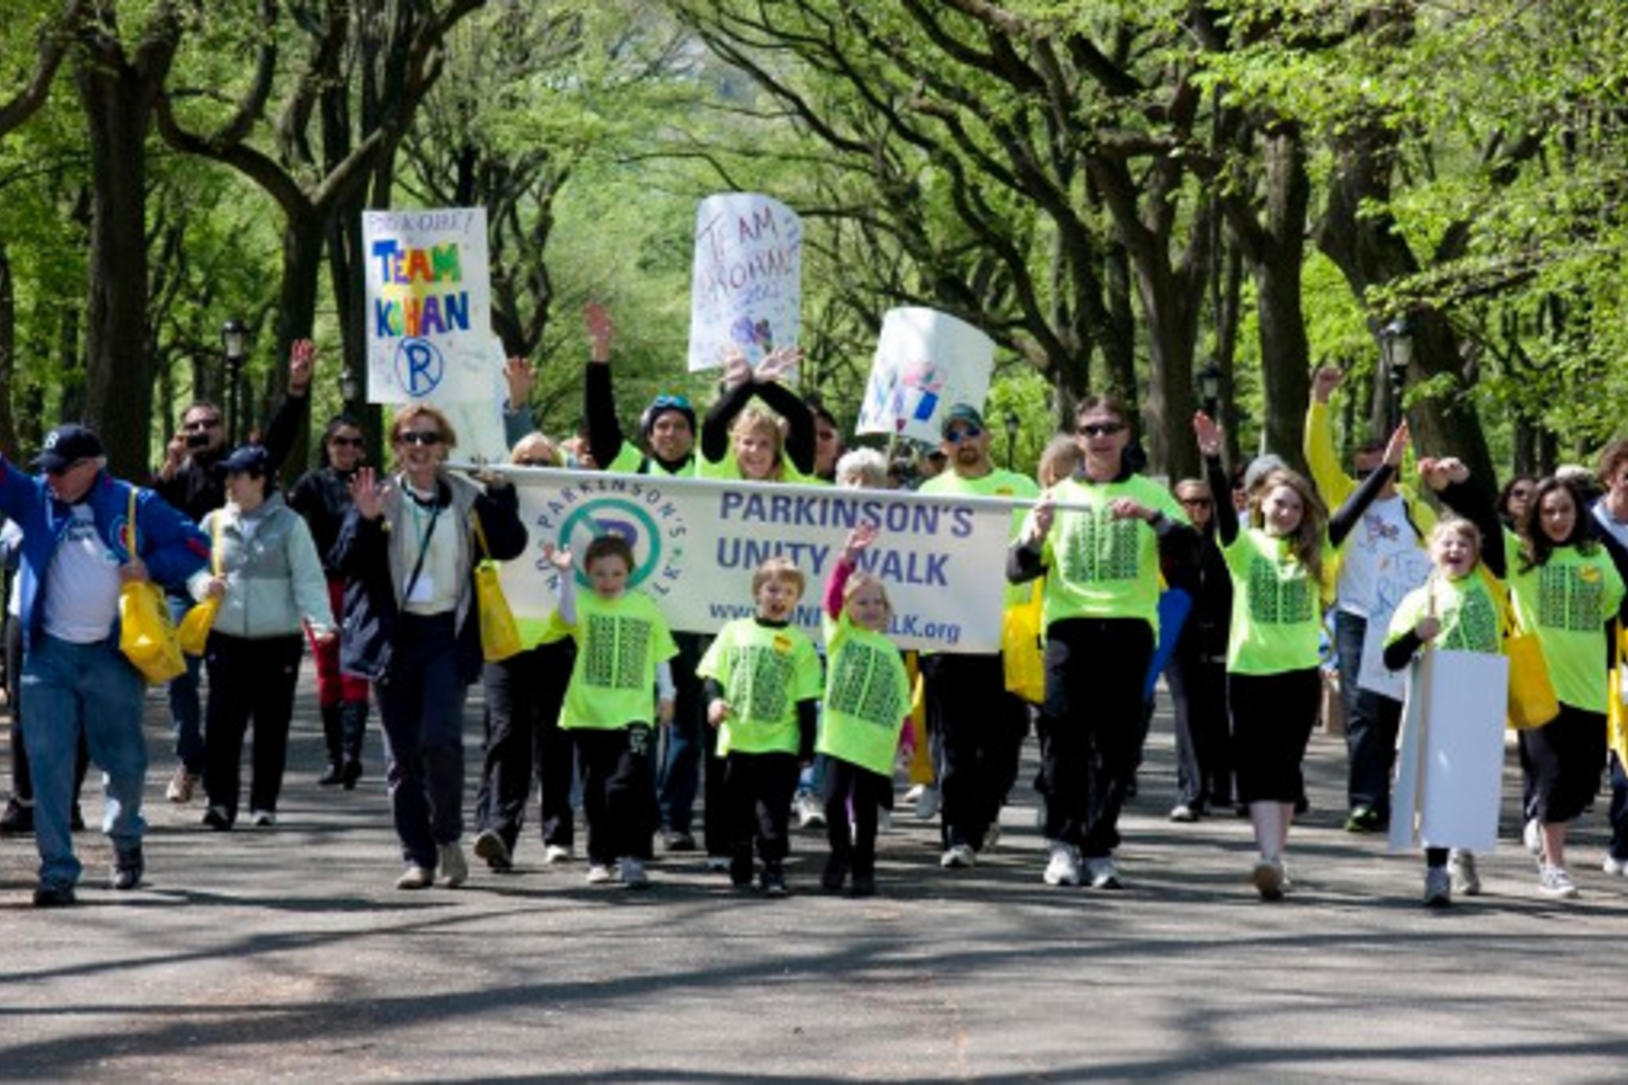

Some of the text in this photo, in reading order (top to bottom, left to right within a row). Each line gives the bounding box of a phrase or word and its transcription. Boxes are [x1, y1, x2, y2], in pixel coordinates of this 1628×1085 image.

[372, 239, 461, 284] TEAM
[374, 291, 470, 337] KOHAN
[537, 478, 687, 539] PARKINSON'S
[719, 490, 975, 539] PARKINSON'S
[853, 546, 950, 587] WALK
